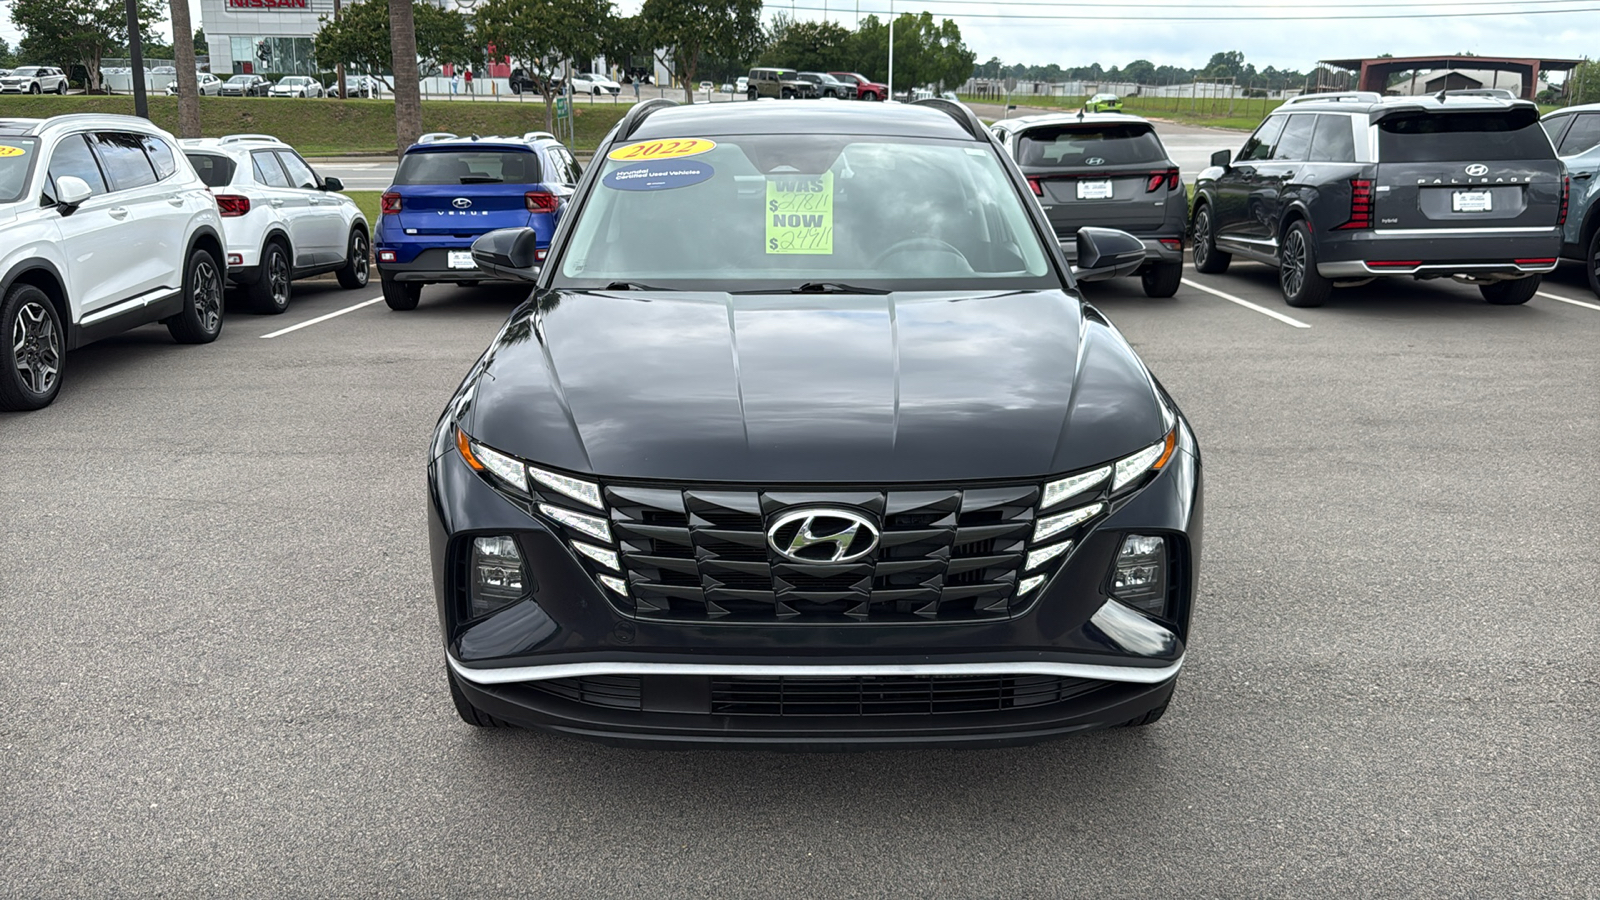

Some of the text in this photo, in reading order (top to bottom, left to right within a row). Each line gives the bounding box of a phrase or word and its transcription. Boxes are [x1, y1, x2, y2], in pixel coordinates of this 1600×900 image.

[229, 0, 306, 8] NISSAN
[623, 141, 698, 158] 2022
[615, 172, 648, 180] Certified
[616, 168, 649, 176] Hyundai
[775, 180, 824, 193] WAS
[773, 214, 824, 228] NOW
